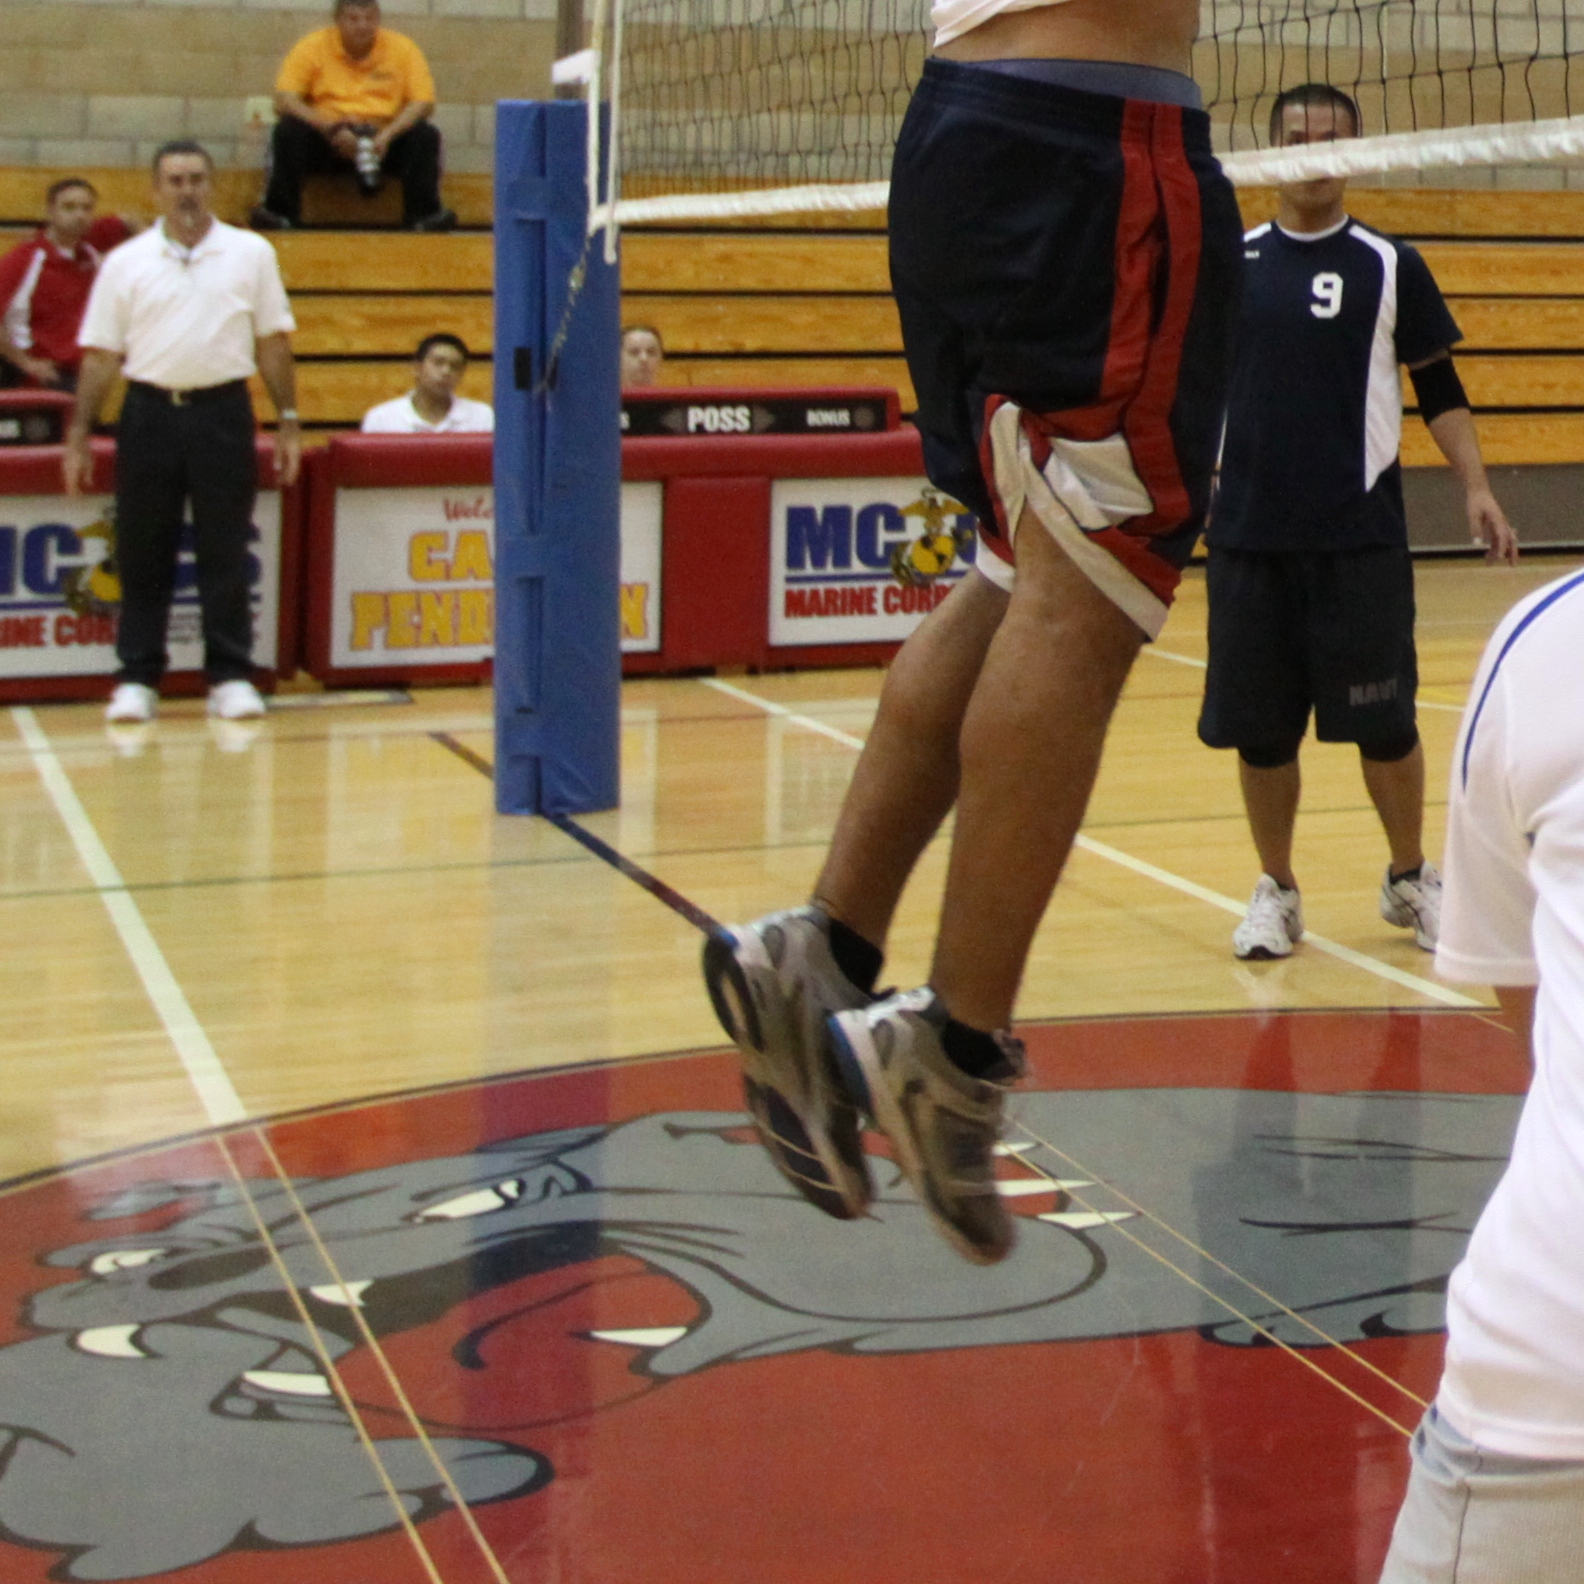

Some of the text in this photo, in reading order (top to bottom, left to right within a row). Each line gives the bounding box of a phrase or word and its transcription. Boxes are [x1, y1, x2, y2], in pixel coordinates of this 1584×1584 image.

[1310, 271, 1344, 319] 9
[687, 405, 751, 432] POSS
[806, 408, 850, 427] BONUS
[408, 529, 494, 581] CA
[785, 583, 957, 618] MARINE CORP
